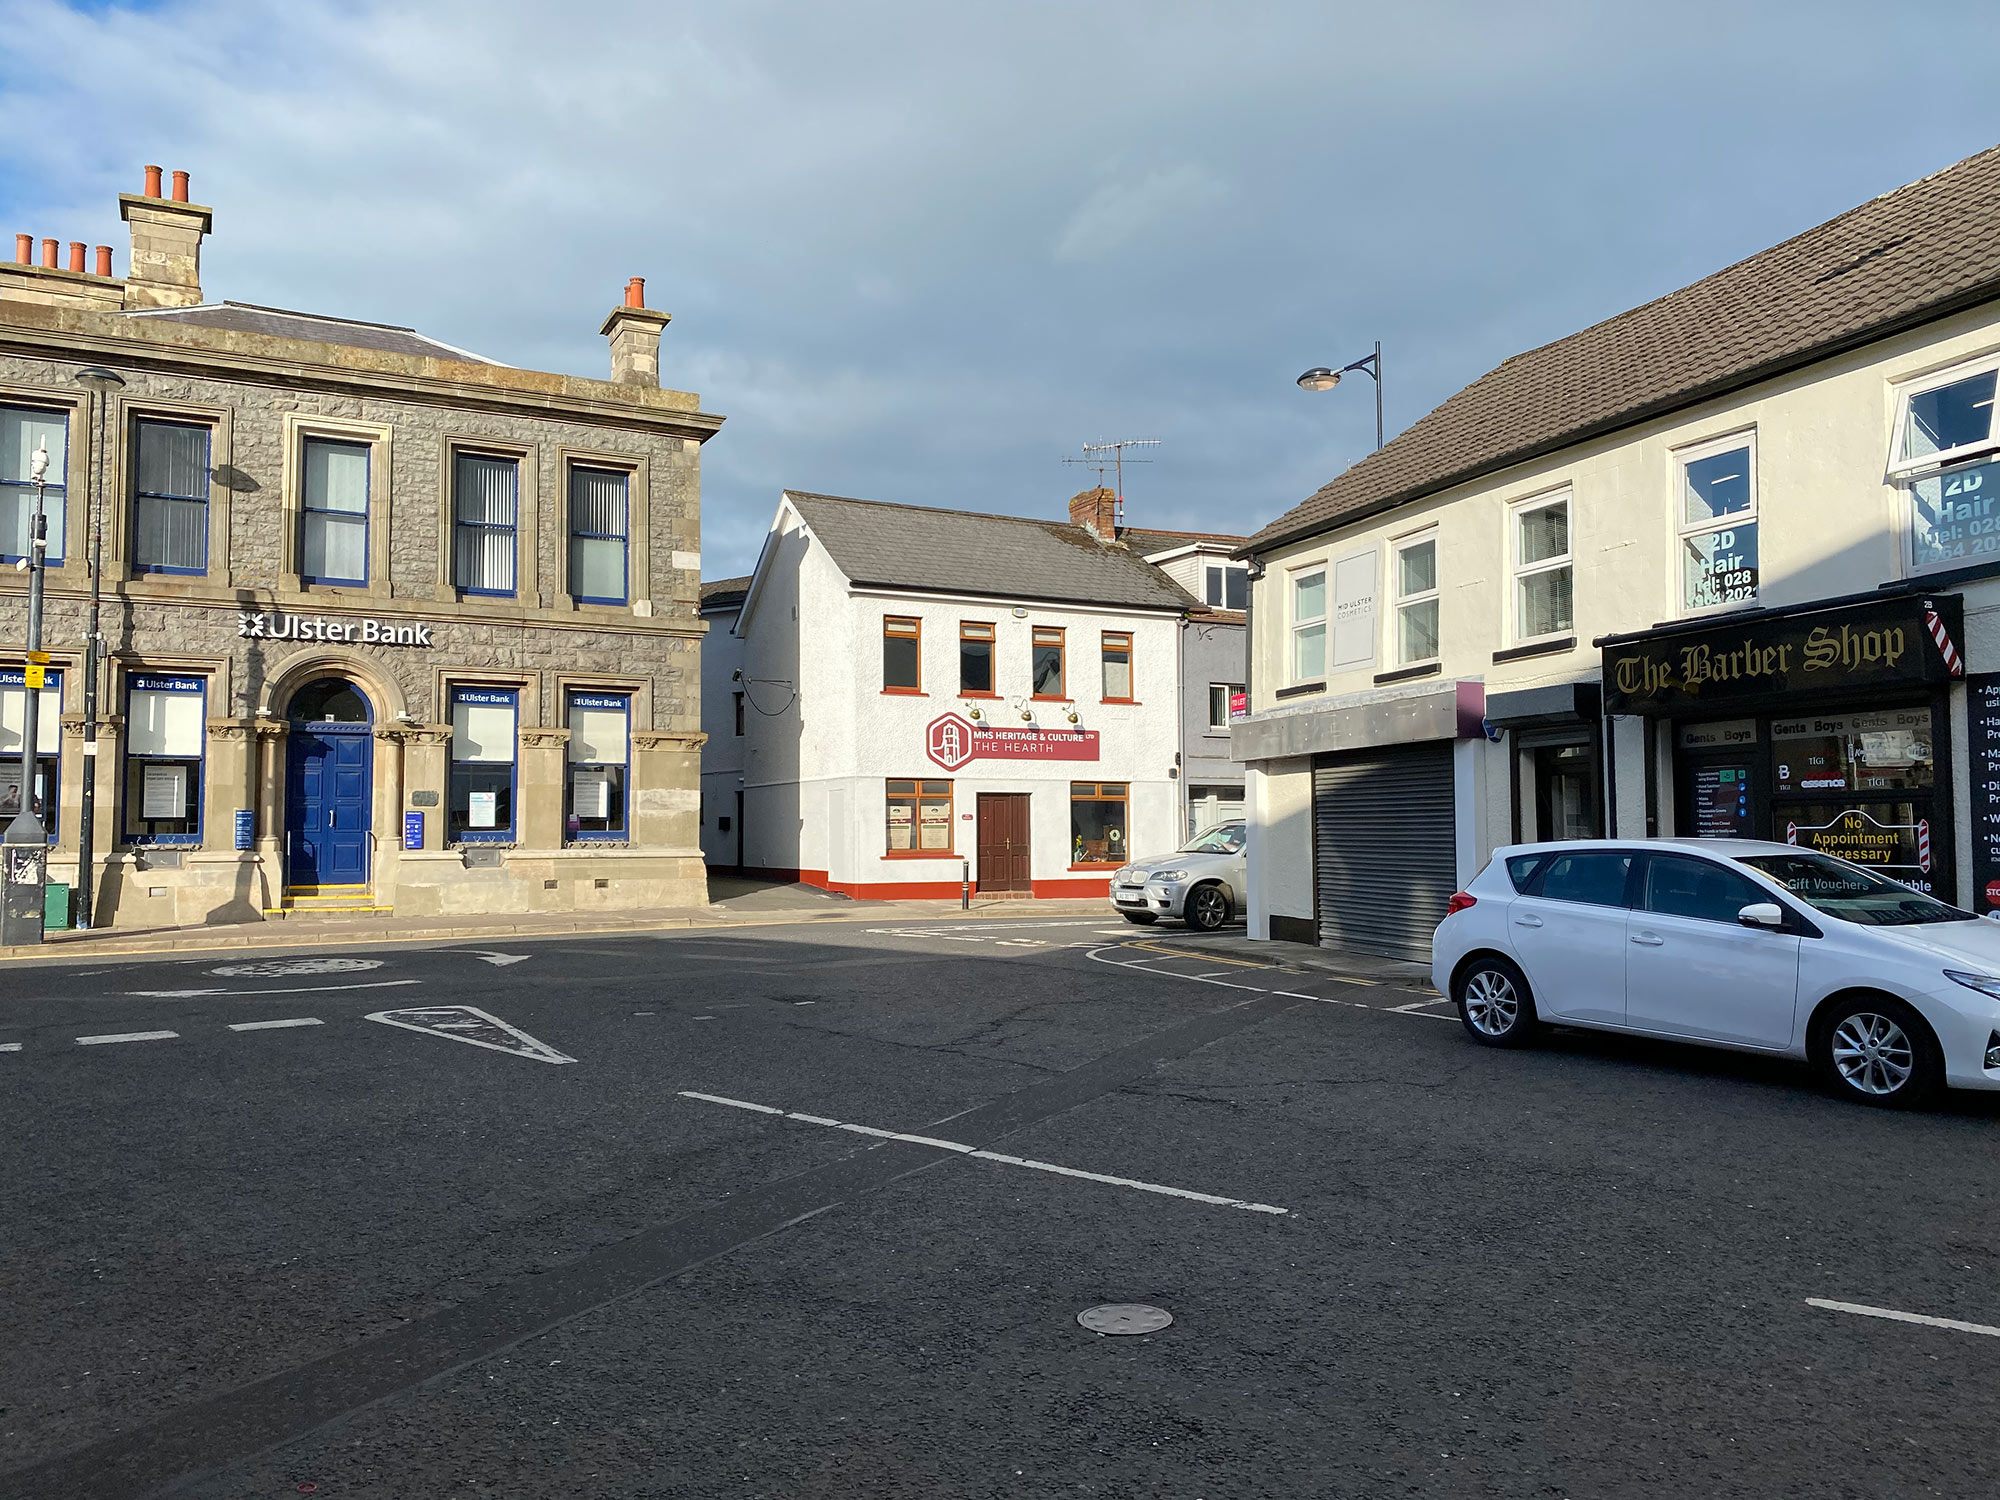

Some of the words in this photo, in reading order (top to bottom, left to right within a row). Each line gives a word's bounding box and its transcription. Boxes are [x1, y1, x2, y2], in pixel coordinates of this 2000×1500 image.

[1945, 469, 1983, 497] 2D
[1934, 496, 1995, 525] Hair
[1711, 530, 1735, 552] 2D
[1700, 553, 1744, 577] Hair
[1724, 569, 1752, 587] 028
[1337, 602, 1348, 611] MID
[1349, 596, 1372, 608] ULSTER
[1336, 604, 1372, 620] COSMETICS
[268, 614, 355, 642] Ulster
[362, 619, 431, 645] Bank
[1614, 655, 1672, 698] The
[1679, 638, 1793, 692] Barber
[1803, 623, 1905, 674] Shop
[146, 679, 173, 689] Ulster
[174, 681, 198, 690] Bank
[466, 693, 490, 702] Ulster
[490, 694, 510, 703] Bank
[581, 698, 604, 706] Ulster
[604, 699, 622, 707] Bank
[1774, 722, 1806, 735] Gents
[1814, 720, 1843, 733] Boys
[1851, 715, 1888, 729] Gents
[1896, 713, 1929, 727] Boys
[973, 731, 994, 739] MHS
[995, 731, 1037, 740] HERITAGE
[1039, 733, 1046, 741] &
[1047, 733, 1084, 742] CULTURE
[1686, 733, 1716, 744] Gents
[1724, 729, 1752, 742] Boys
[974, 741, 998, 751] THE
[1004, 742, 1054, 753] HEARTH
[1800, 778, 1846, 789] essence
[1867, 777, 1885, 787] TIGI
[1844, 816, 1863, 829] No
[1813, 832, 1899, 847] Appointment
[1788, 878, 1810, 890] Gift
[1813, 878, 1870, 891] Vouchers
